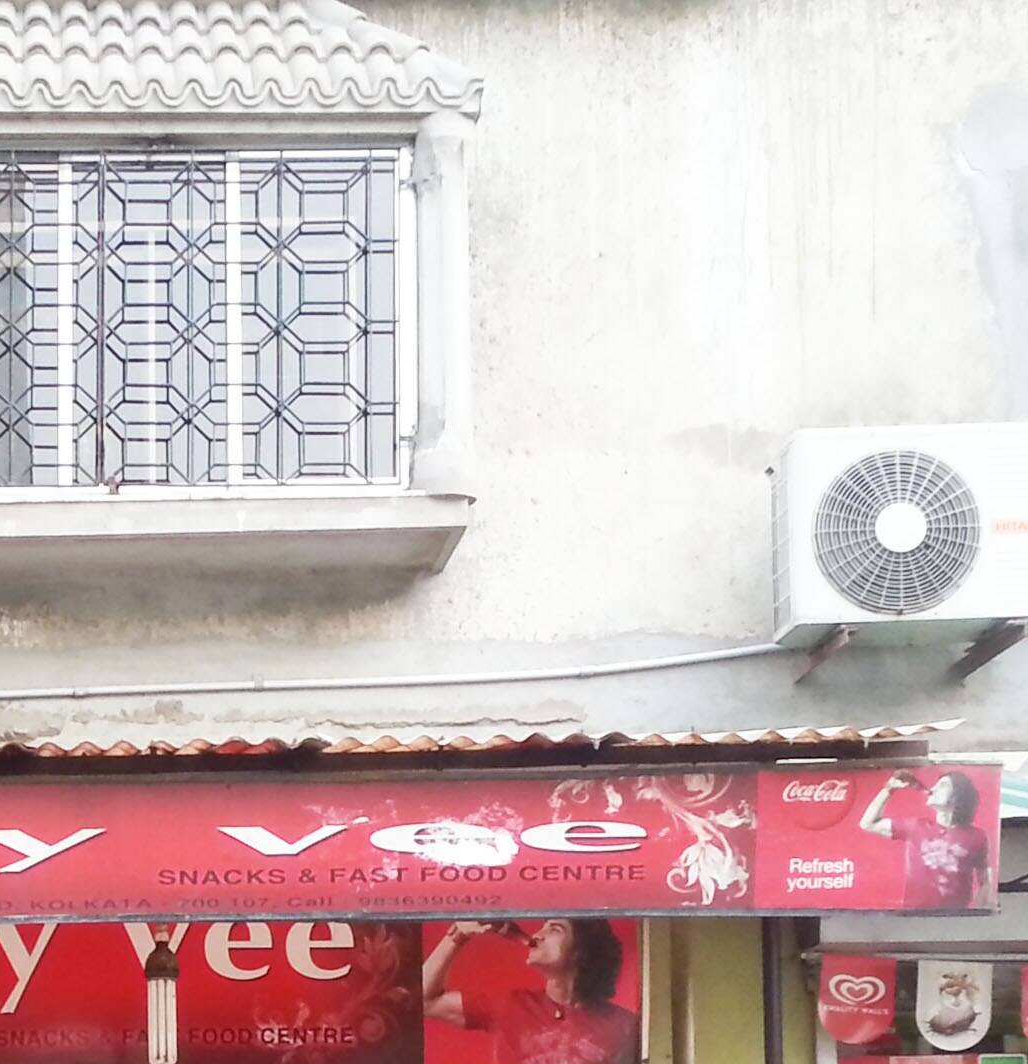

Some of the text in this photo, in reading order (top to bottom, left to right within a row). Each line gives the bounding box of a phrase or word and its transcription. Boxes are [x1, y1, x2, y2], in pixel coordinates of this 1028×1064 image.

[782, 779, 850, 802] Coca-Cola
[157, 864, 646, 886] SNACKS & FAST FOOD CENTRE
[789, 858, 854, 874] Refresh
[786, 873, 854, 893] yourself
[29, 898, 152, 911] KOLKATA
[178, 896, 219, 909] 700
[286, 895, 333, 908] Call
[188, 1028, 253, 1045] FOOD
[261, 1027, 354, 1045] CENTRE
